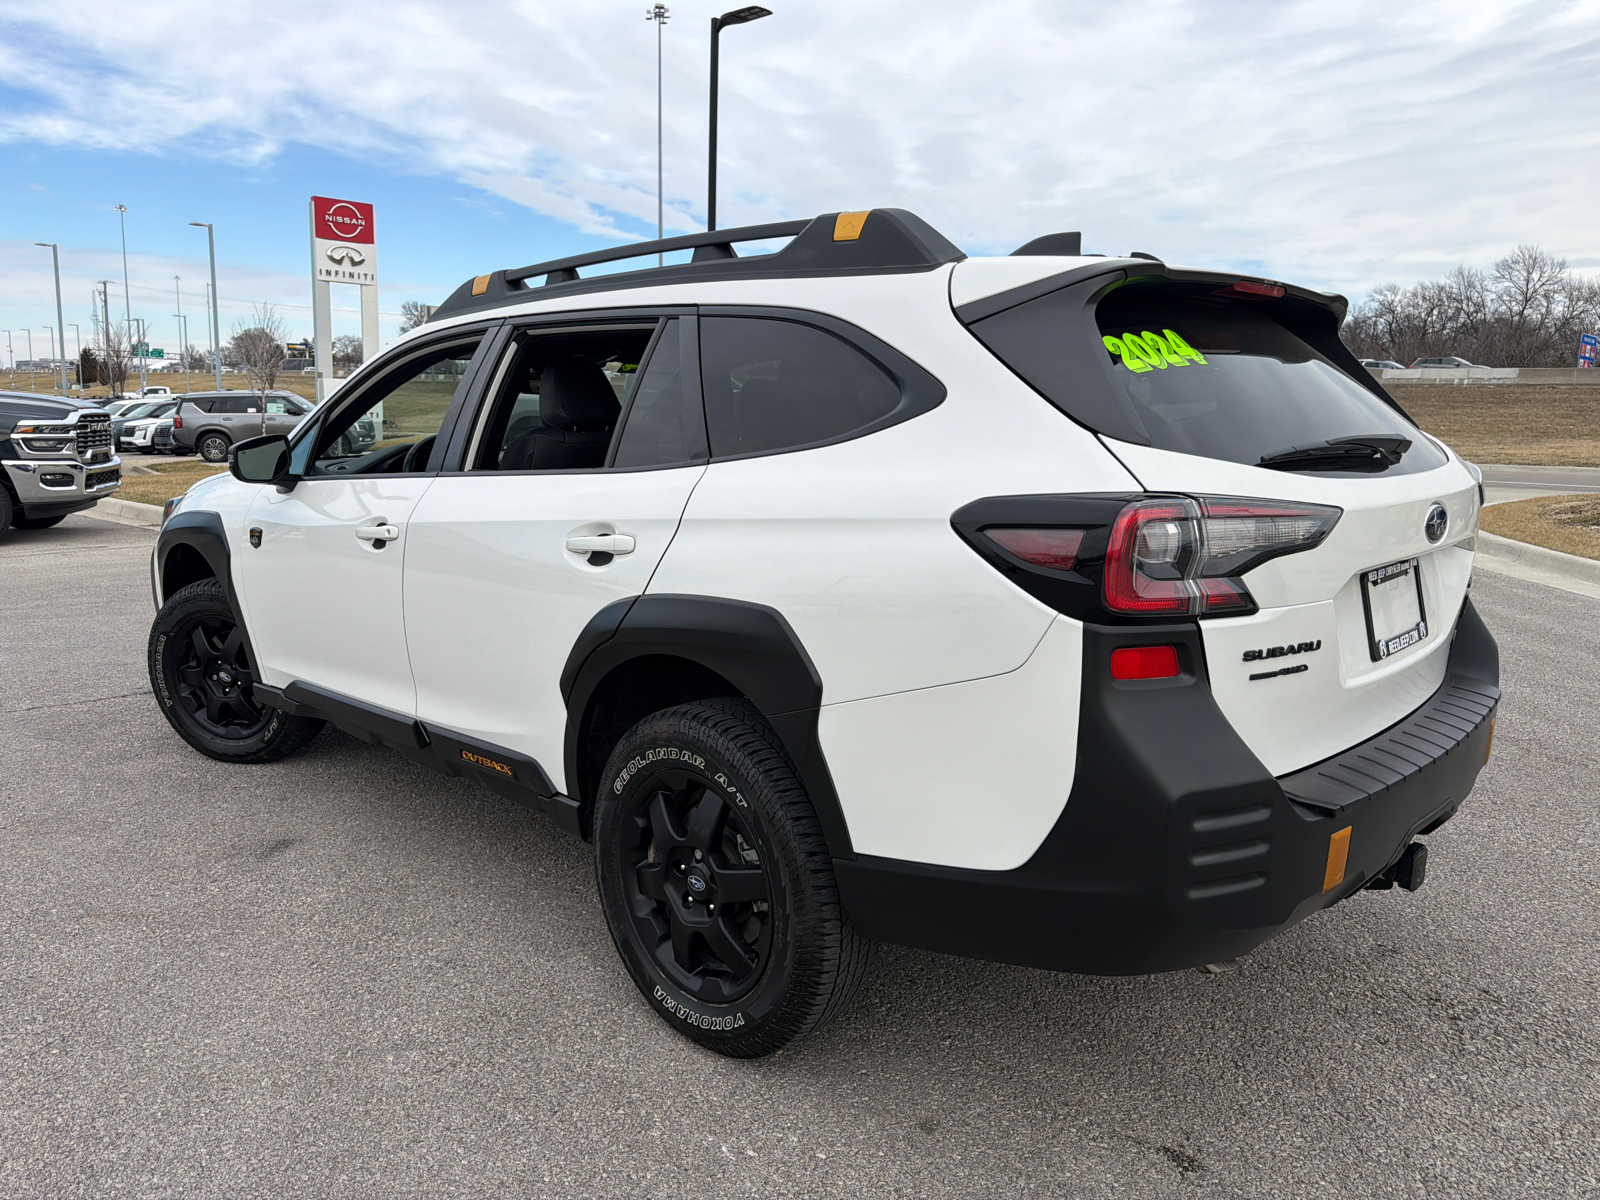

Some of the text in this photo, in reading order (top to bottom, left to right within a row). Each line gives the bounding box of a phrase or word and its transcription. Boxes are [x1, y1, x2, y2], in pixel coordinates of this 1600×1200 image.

[325, 215, 365, 226] NISSAN
[319, 268, 375, 281] INFINITI
[1102, 329, 1208, 374] 2024
[1242, 639, 1322, 662] SUBARU
[1275, 663, 1309, 677] AWD
[462, 750, 513, 776] OUTBACK
[613, 747, 748, 808] GEOLANDAR A/T
[653, 985, 745, 1031] YOKOHAMA
